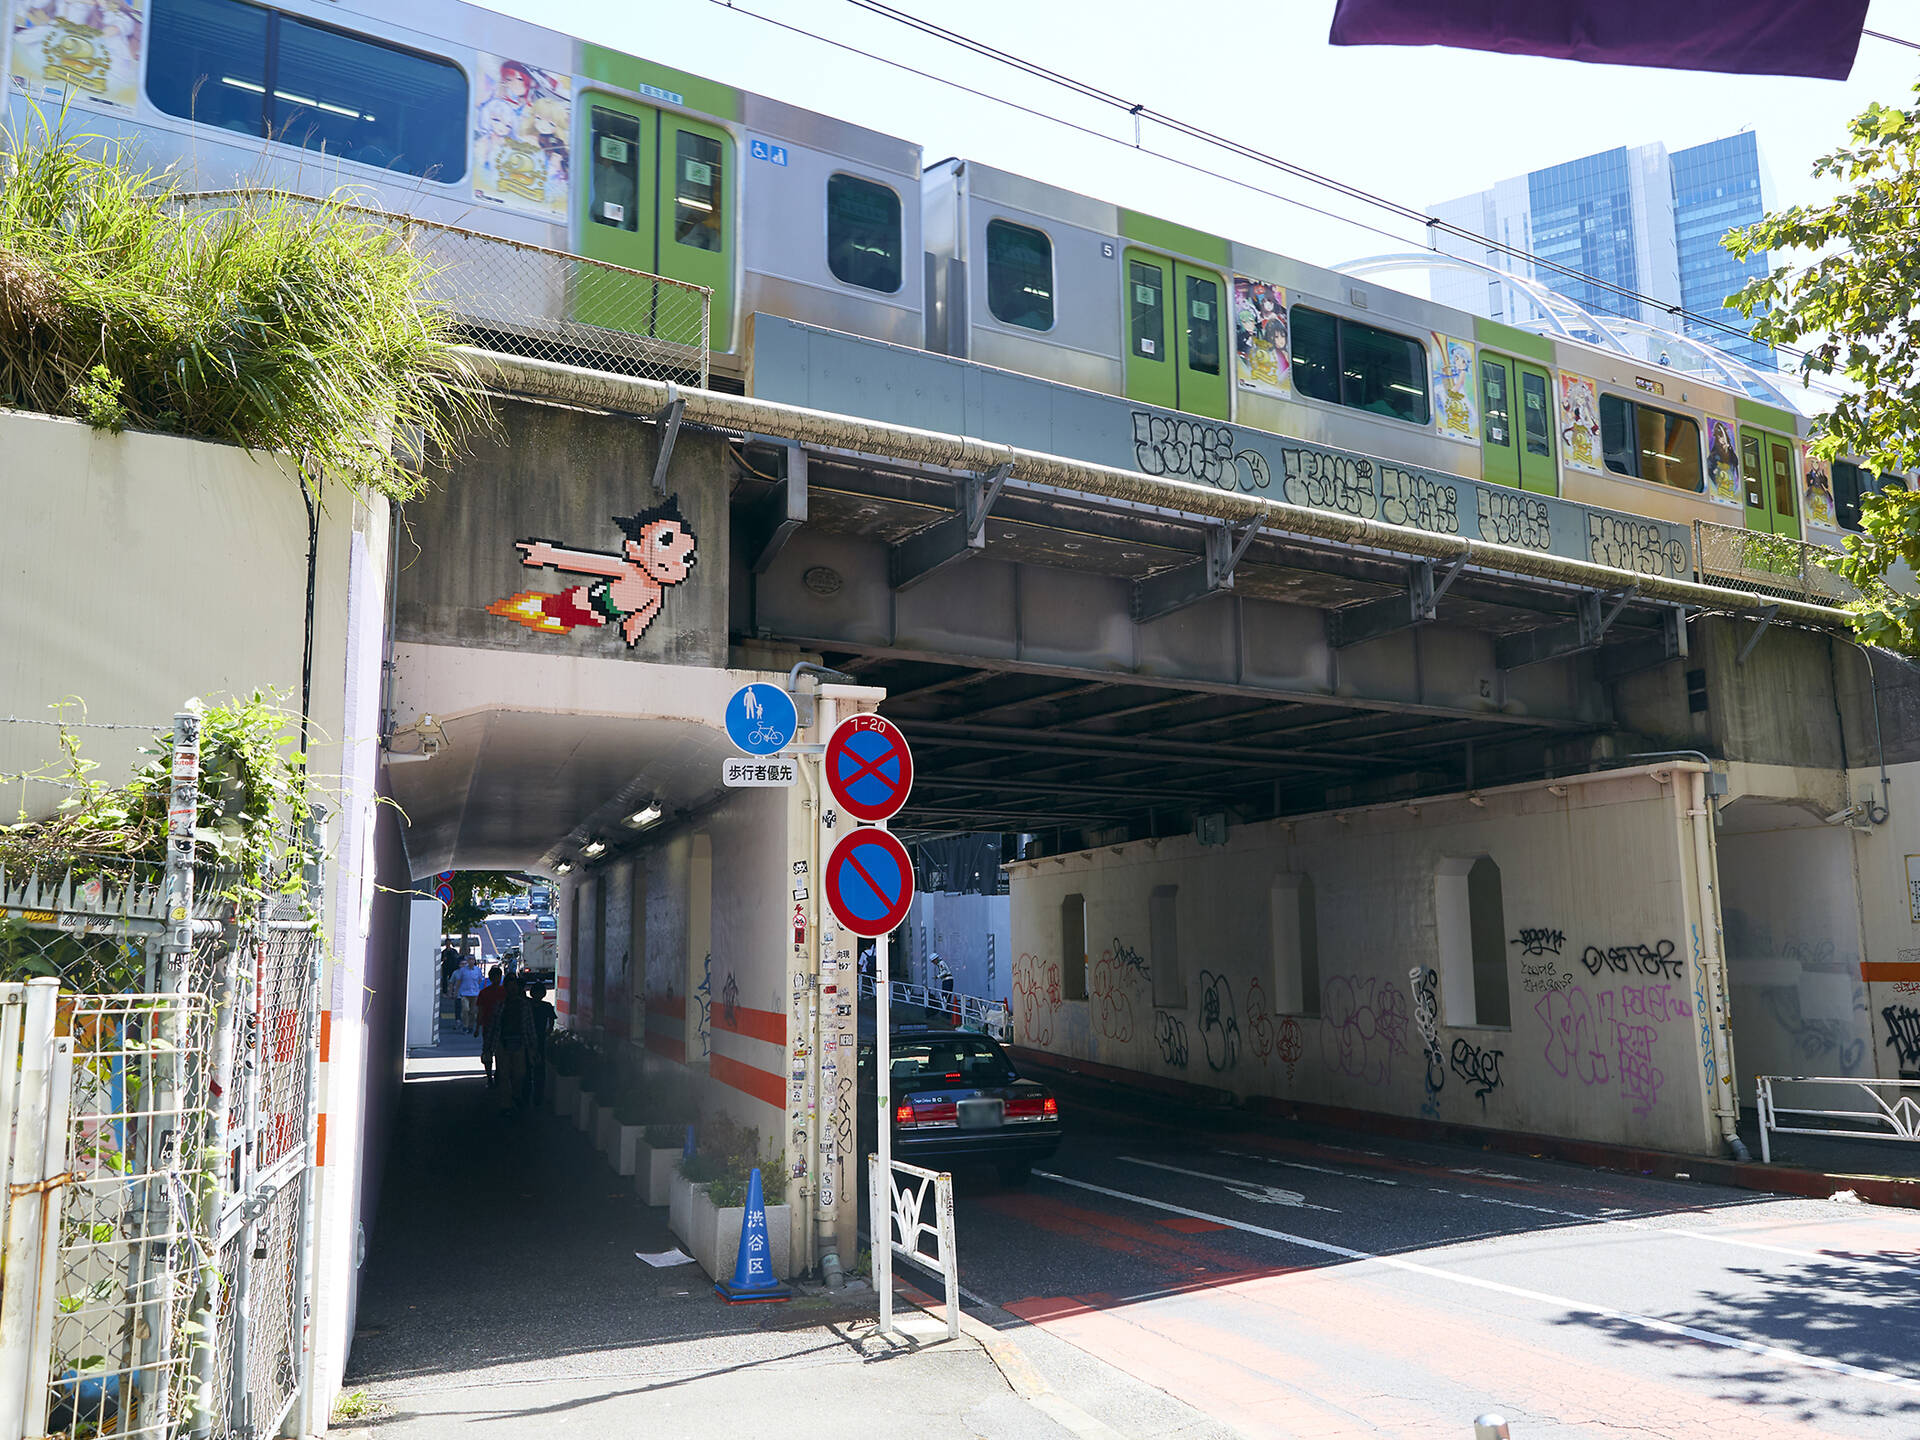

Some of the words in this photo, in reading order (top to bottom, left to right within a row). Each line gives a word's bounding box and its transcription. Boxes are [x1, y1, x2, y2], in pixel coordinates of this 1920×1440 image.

[1103, 244, 1113, 257] 5
[850, 718, 886, 734] 7-20
[728, 764, 793, 782] 歩行者優先
[747, 1210, 765, 1274] 渋谷区
